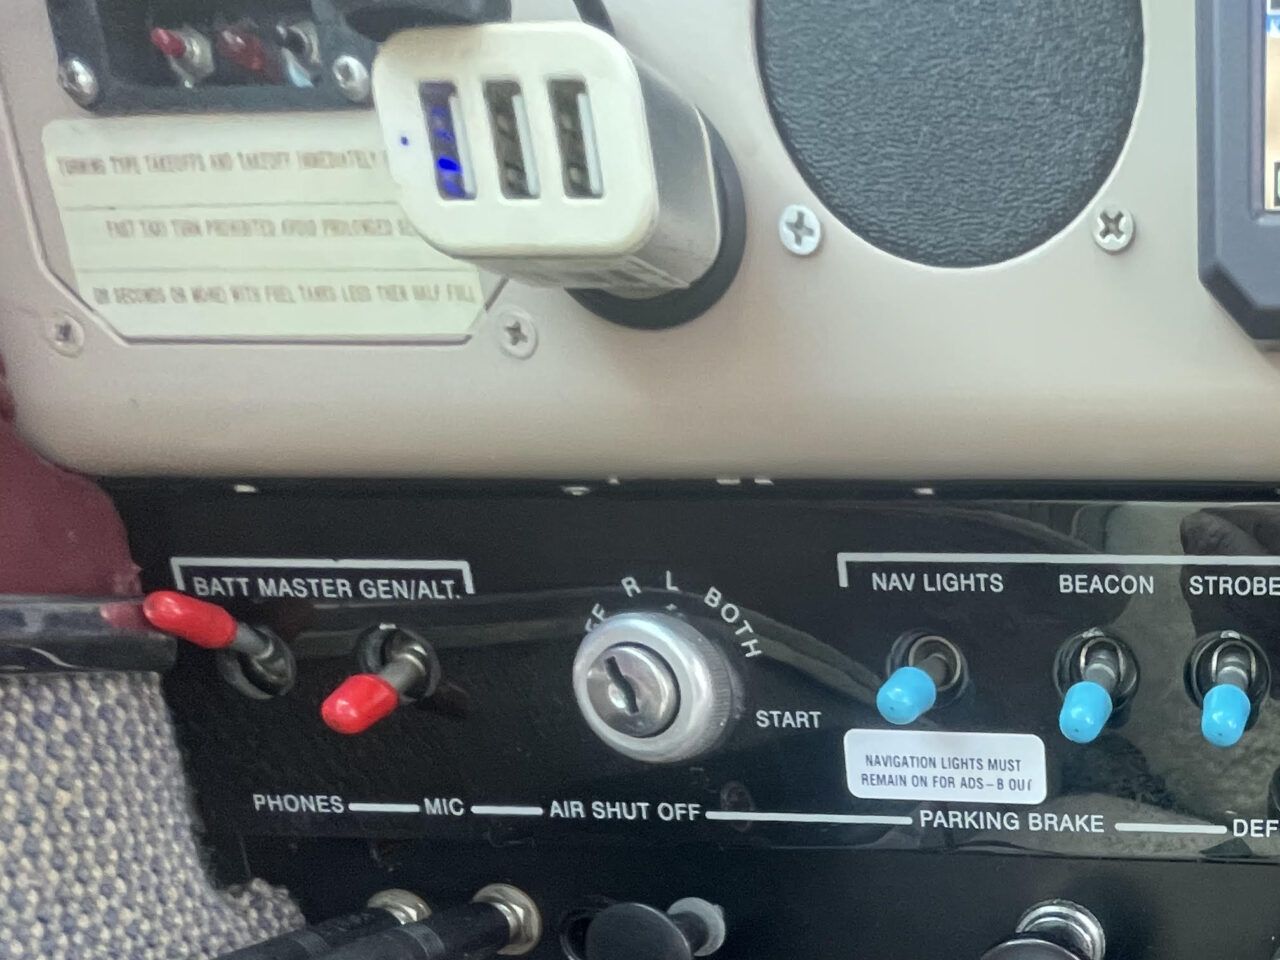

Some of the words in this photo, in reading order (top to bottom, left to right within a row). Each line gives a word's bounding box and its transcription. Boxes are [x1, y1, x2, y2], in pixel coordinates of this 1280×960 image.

[192, 576, 250, 597] BATT
[257, 577, 353, 599] MASTER
[359, 579, 461, 601] GEN/ALT.
[621, 576, 642, 597] R
[665, 570, 680, 592] L
[871, 572, 920, 593] NAV
[924, 572, 1004, 594] LIGHTS
[1059, 574, 1155, 595] BEACON
[703, 586, 763, 658] BOTH
[755, 710, 822, 729] START
[865, 754, 937, 769] NAVIGATION
[941, 756, 984, 771] LIGHTS
[988, 758, 1022, 772] MUST
[860, 773, 908, 787] REMAIN
[911, 774, 928, 788] ON
[932, 775, 956, 788] FOR
[252, 793, 345, 814] PHONES
[424, 798, 464, 817] MIC
[549, 801, 586, 820] AIR
[591, 802, 651, 822] SHUT
[656, 802, 702, 822] OFF
[918, 809, 1021, 832] PARKING
[1028, 812, 1105, 834] BRAKE
